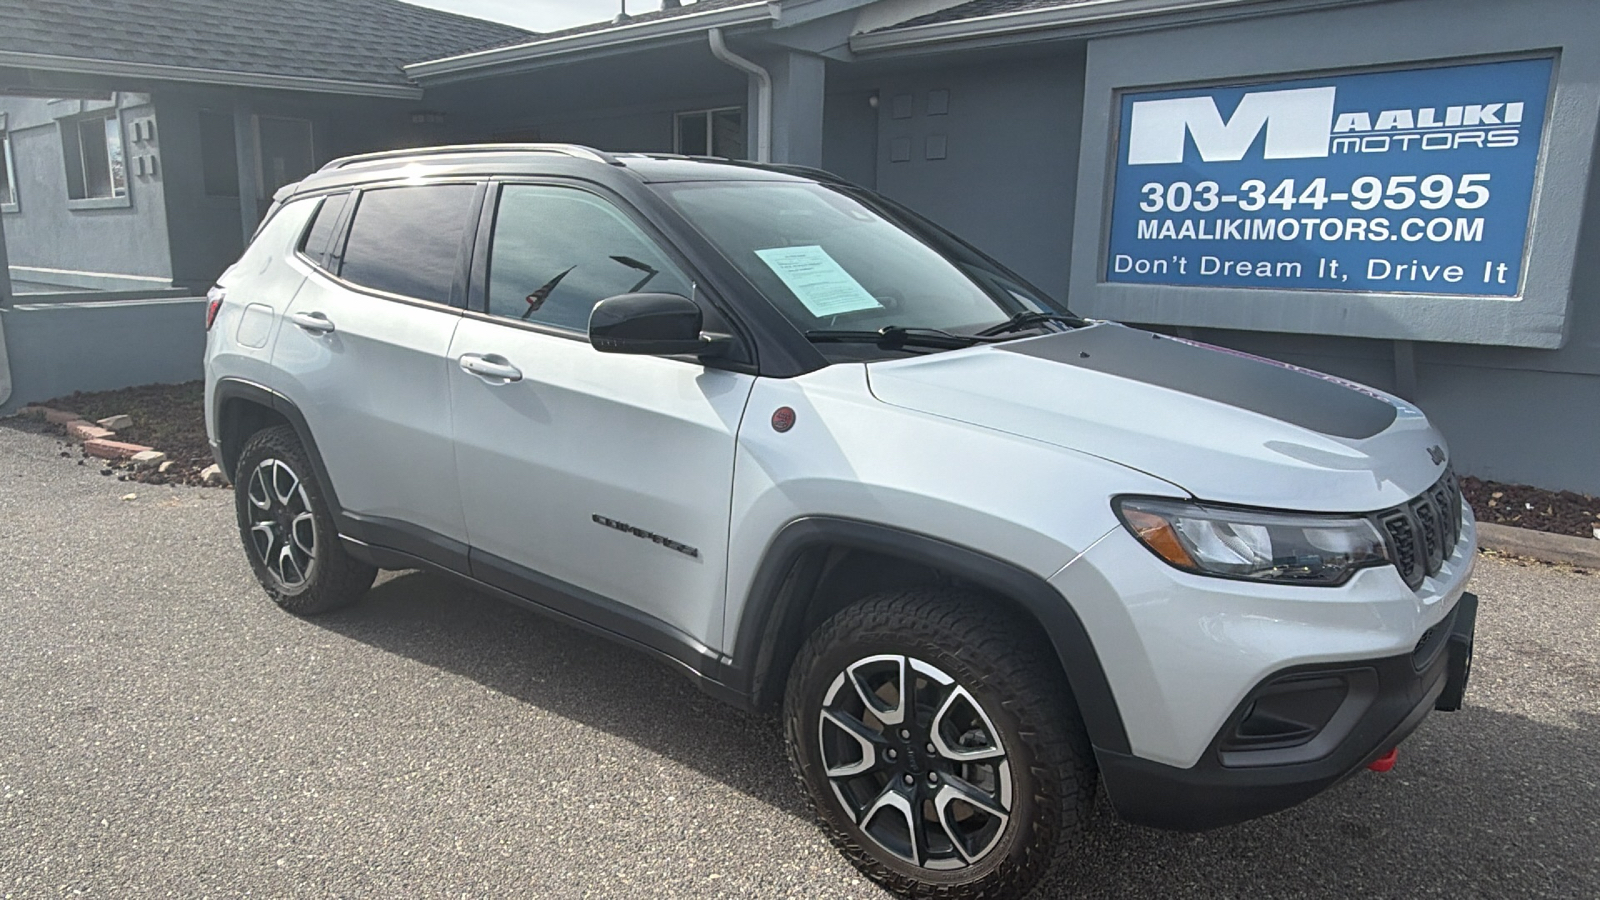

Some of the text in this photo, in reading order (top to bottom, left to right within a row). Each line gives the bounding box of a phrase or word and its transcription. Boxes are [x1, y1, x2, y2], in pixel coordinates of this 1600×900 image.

[1333, 130, 1519, 153] MOTORS
[1140, 173, 1491, 212] 303-344-9595
[1137, 217, 1484, 242] MAALIKIMOTORS.COM
[1114, 254, 1508, 284] Don't Dream It, Drive It
